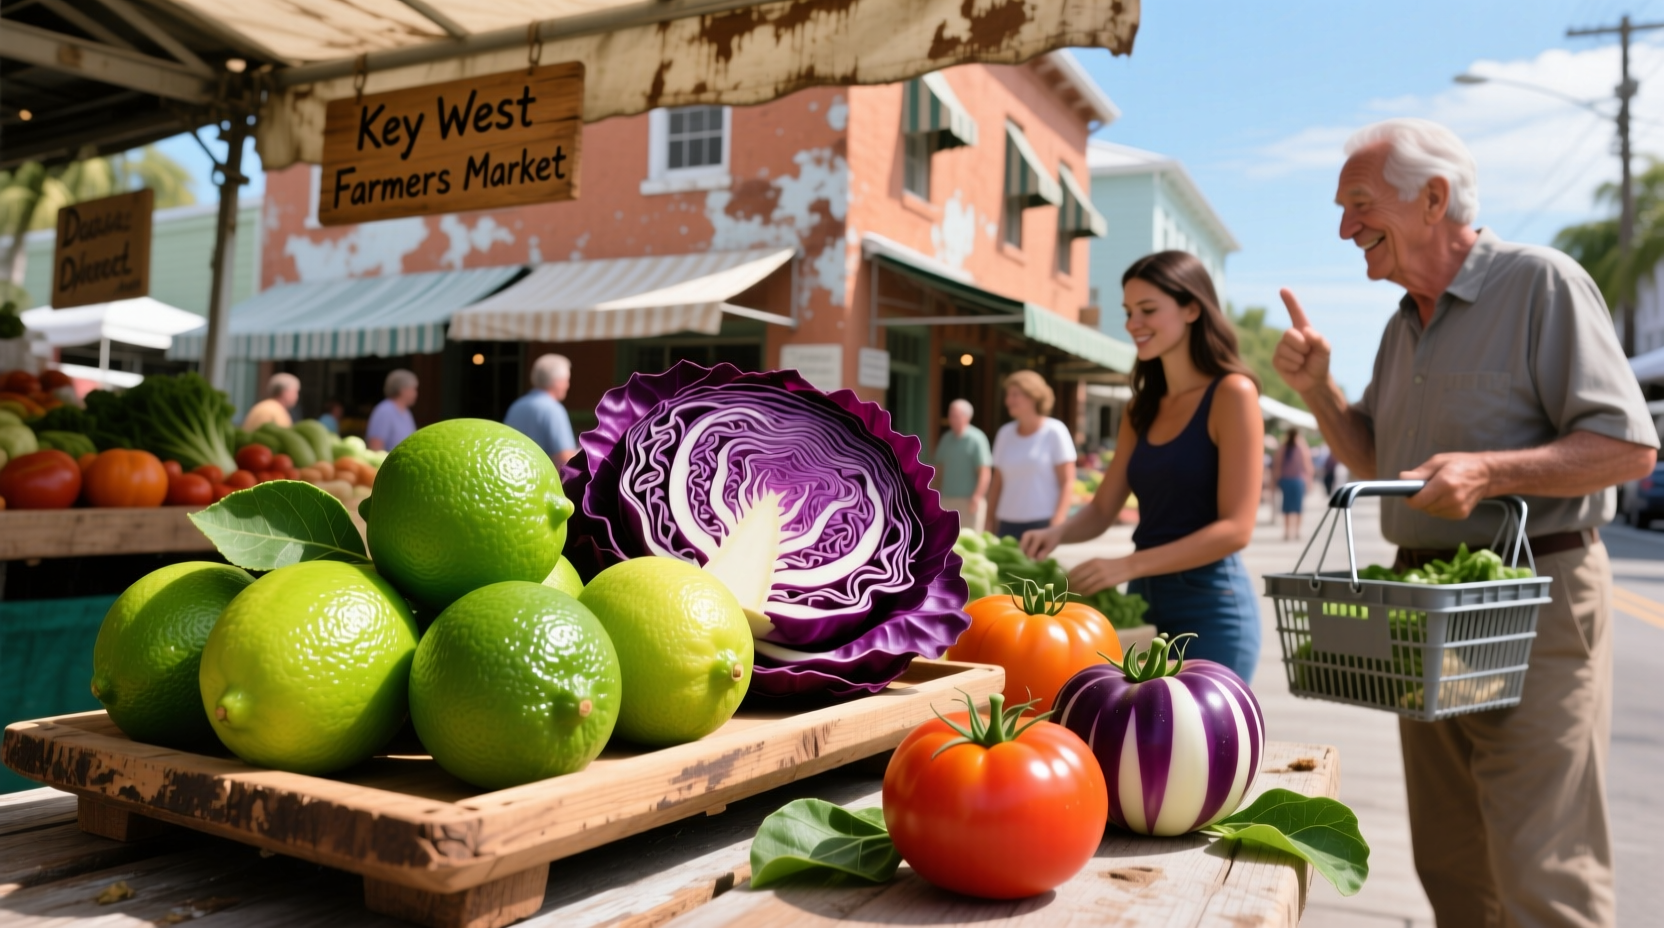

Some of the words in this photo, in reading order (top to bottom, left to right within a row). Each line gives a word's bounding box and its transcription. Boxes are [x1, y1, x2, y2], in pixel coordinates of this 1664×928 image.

[357, 104, 424, 160] Key
[437, 86, 536, 140] West
[333, 166, 450, 209] Farmers
[463, 146, 566, 191] Market
